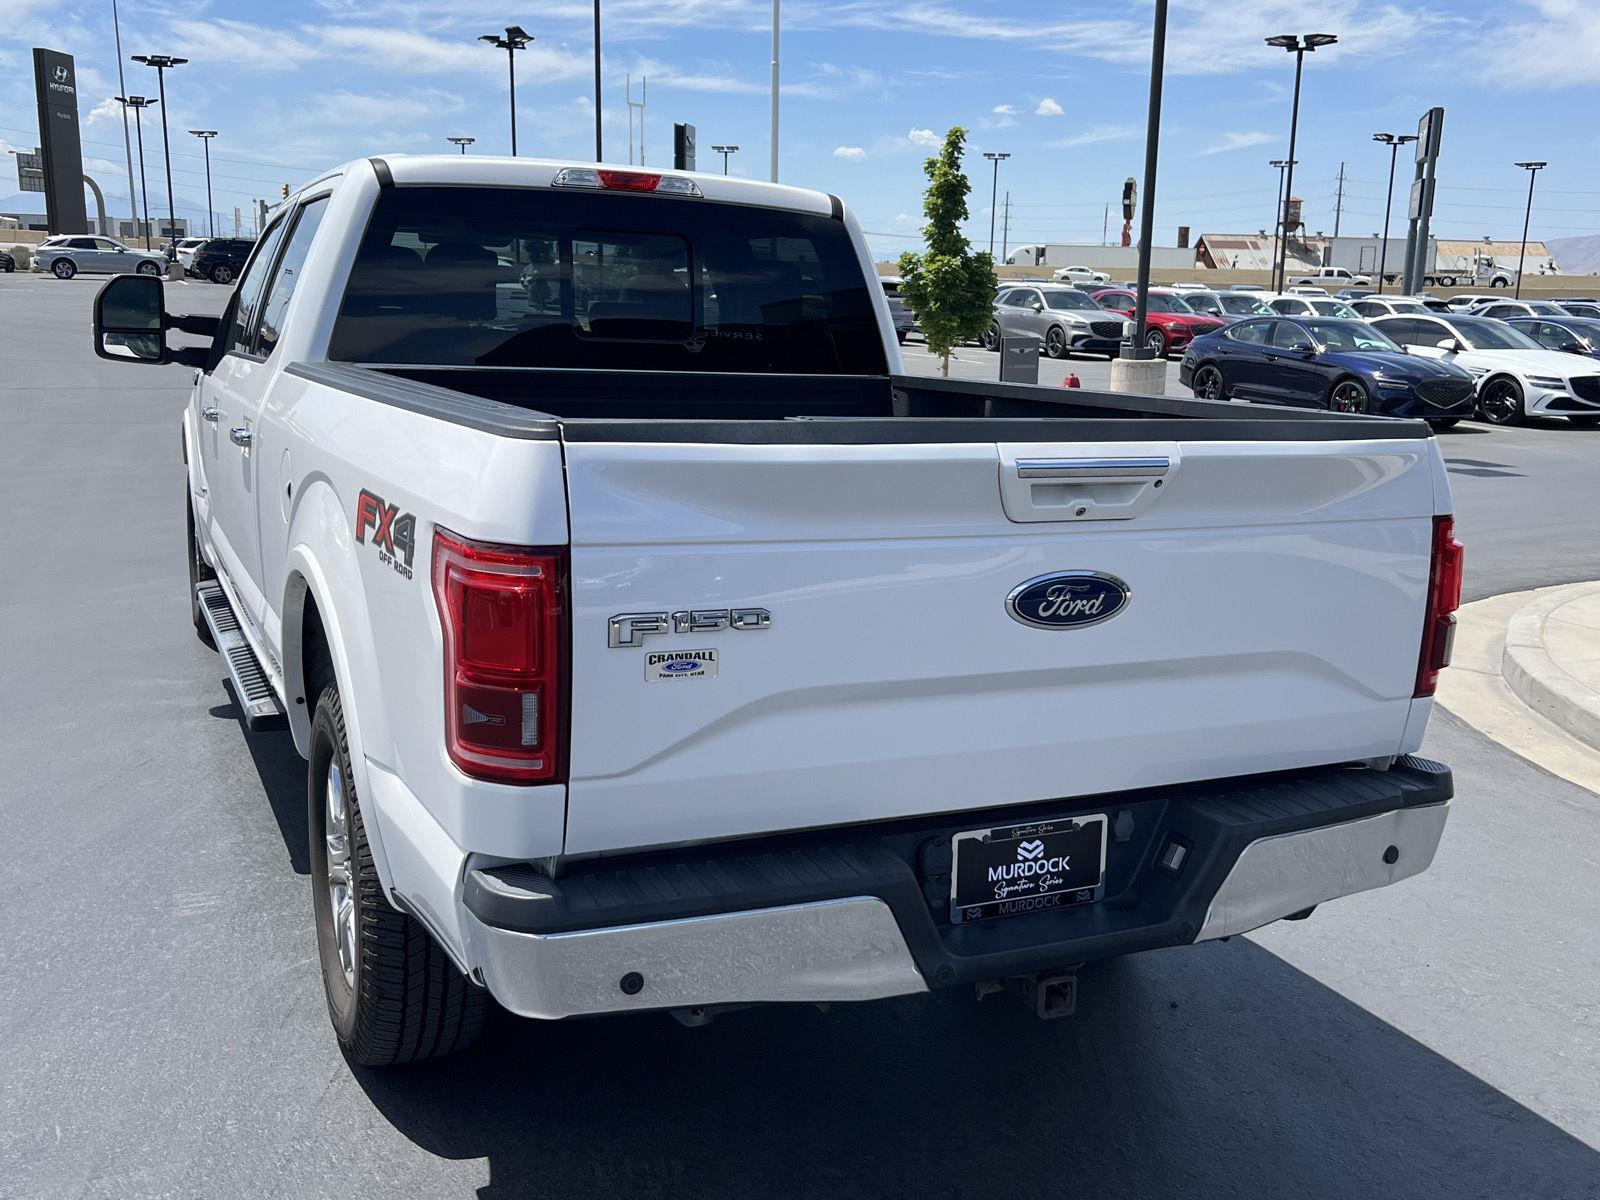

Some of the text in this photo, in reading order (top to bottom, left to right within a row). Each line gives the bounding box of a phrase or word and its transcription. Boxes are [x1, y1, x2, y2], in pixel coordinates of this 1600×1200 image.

[50, 82, 75, 94] HYUNDAI
[356, 488, 416, 569] FX4
[379, 550, 413, 580] OFF ROAD
[1038, 584, 1106, 617] Ford
[649, 651, 715, 666] CRANDALL
[1011, 826, 1036, 838] Signature
[988, 855, 1071, 882] MURDOCK
[994, 874, 1064, 899] Signature Series
[998, 894, 1062, 915] MURDOCK
